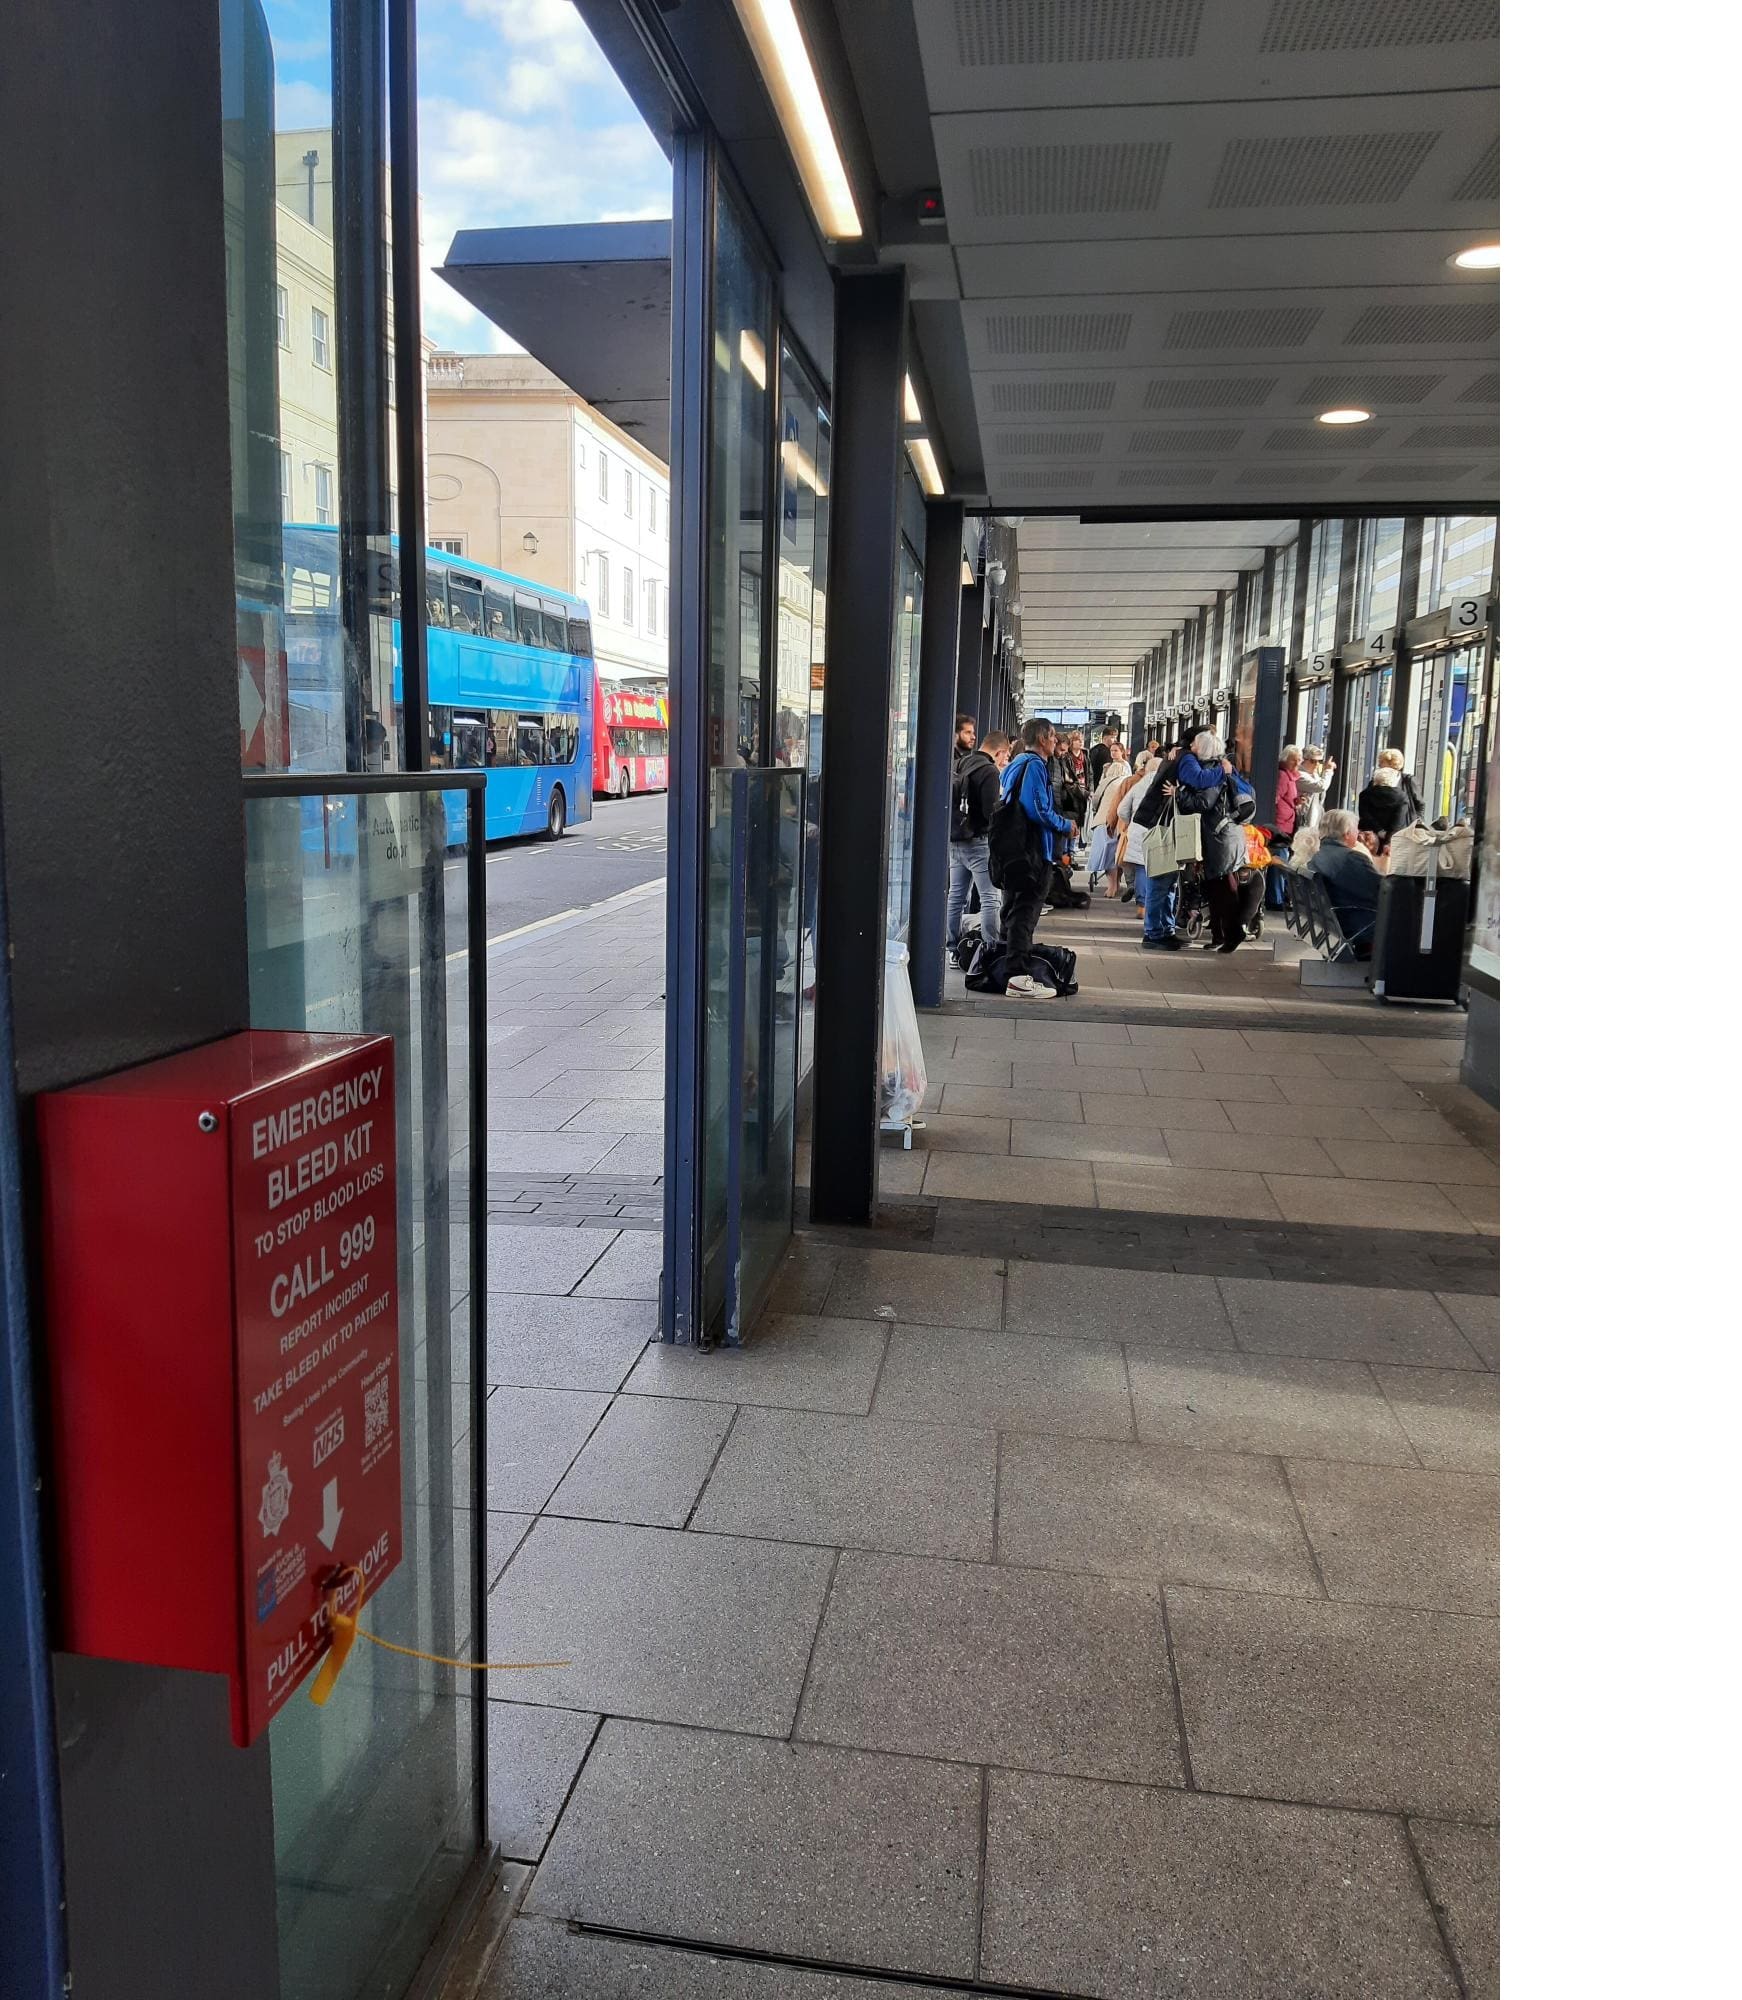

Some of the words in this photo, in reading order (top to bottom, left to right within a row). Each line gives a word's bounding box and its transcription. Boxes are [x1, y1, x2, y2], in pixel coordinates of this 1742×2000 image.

[1459, 601, 1478, 626] 3
[1370, 634, 1386, 653] 4
[1312, 655, 1325, 672] 5
[1181, 703, 1191, 712] 10
[1198, 697, 1205, 707] 9
[1216, 690, 1225, 702] 8
[1148, 715, 1155, 723] 13
[1156, 712, 1164, 720] 12
[1169, 708, 1176, 717] 11
[373, 815, 419, 836] Autoatic
[253, 1066, 383, 1160] EMERGENCY
[268, 1142, 338, 1210] BLEED
[344, 1120, 373, 1166] KIT
[254, 1230, 274, 1259] TO
[277, 1208, 311, 1246] STOP
[313, 1183, 354, 1223] BLOOD
[356, 1163, 384, 1196] LOSS
[270, 1246, 335, 1318] CALL
[339, 1215, 375, 1269] 999
[280, 1308, 323, 1355] REPORT
[325, 1273, 369, 1320] INCIDENT
[253, 1378, 283, 1415] TAKE
[285, 1349, 320, 1391] BLEED
[322, 1333, 338, 1360] KIT
[340, 1322, 353, 1344] TO
[354, 1291, 390, 1333] PATIENT
[315, 1419, 343, 1464] NHS
[268, 1630, 308, 1692] PULL
[310, 1601, 330, 1637] TO
